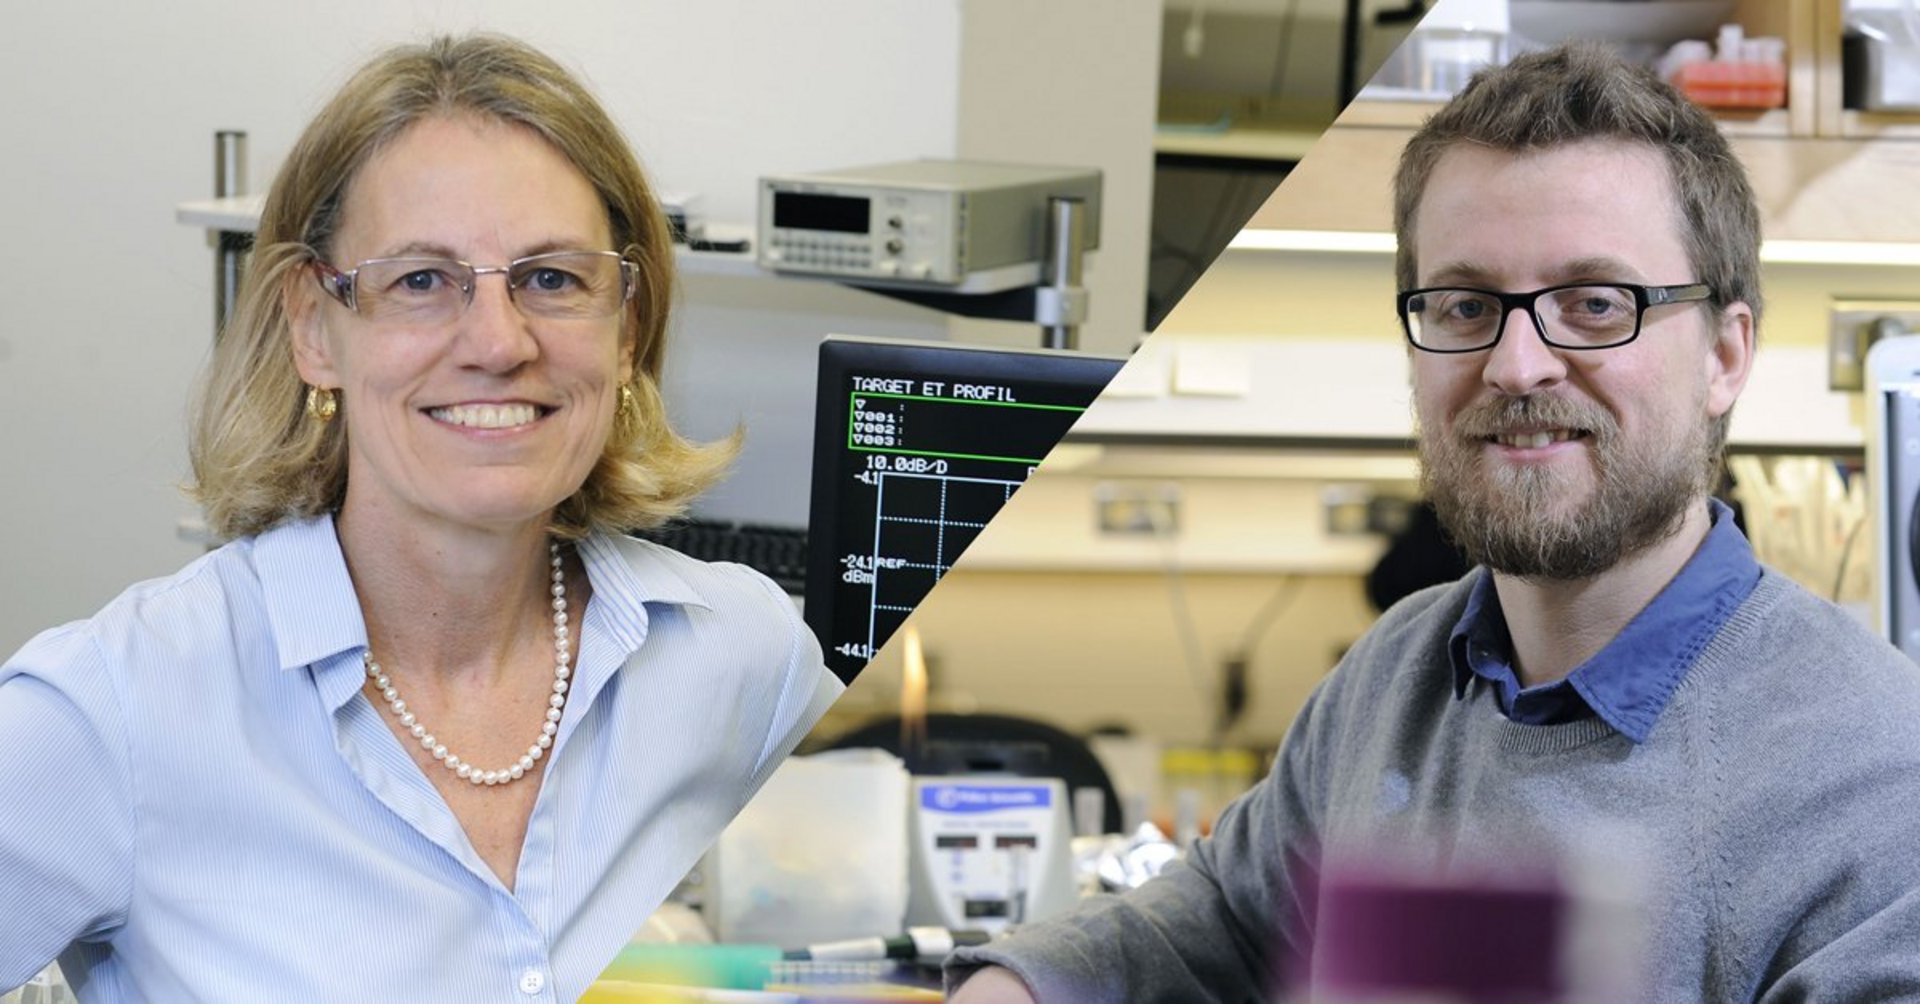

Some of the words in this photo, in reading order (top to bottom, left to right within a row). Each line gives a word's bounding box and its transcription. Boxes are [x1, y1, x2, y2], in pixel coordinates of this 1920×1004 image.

[852, 376, 914, 394] TARGET
[922, 381, 945, 396] ET
[953, 383, 1016, 402] PROFIL
[866, 454, 948, 474] 10.0dB/D
[840, 554, 874, 570] -24.1
[877, 557, 906, 569] REF
[842, 569, 875, 584] dBm
[835, 642, 869, 659] -44.1
